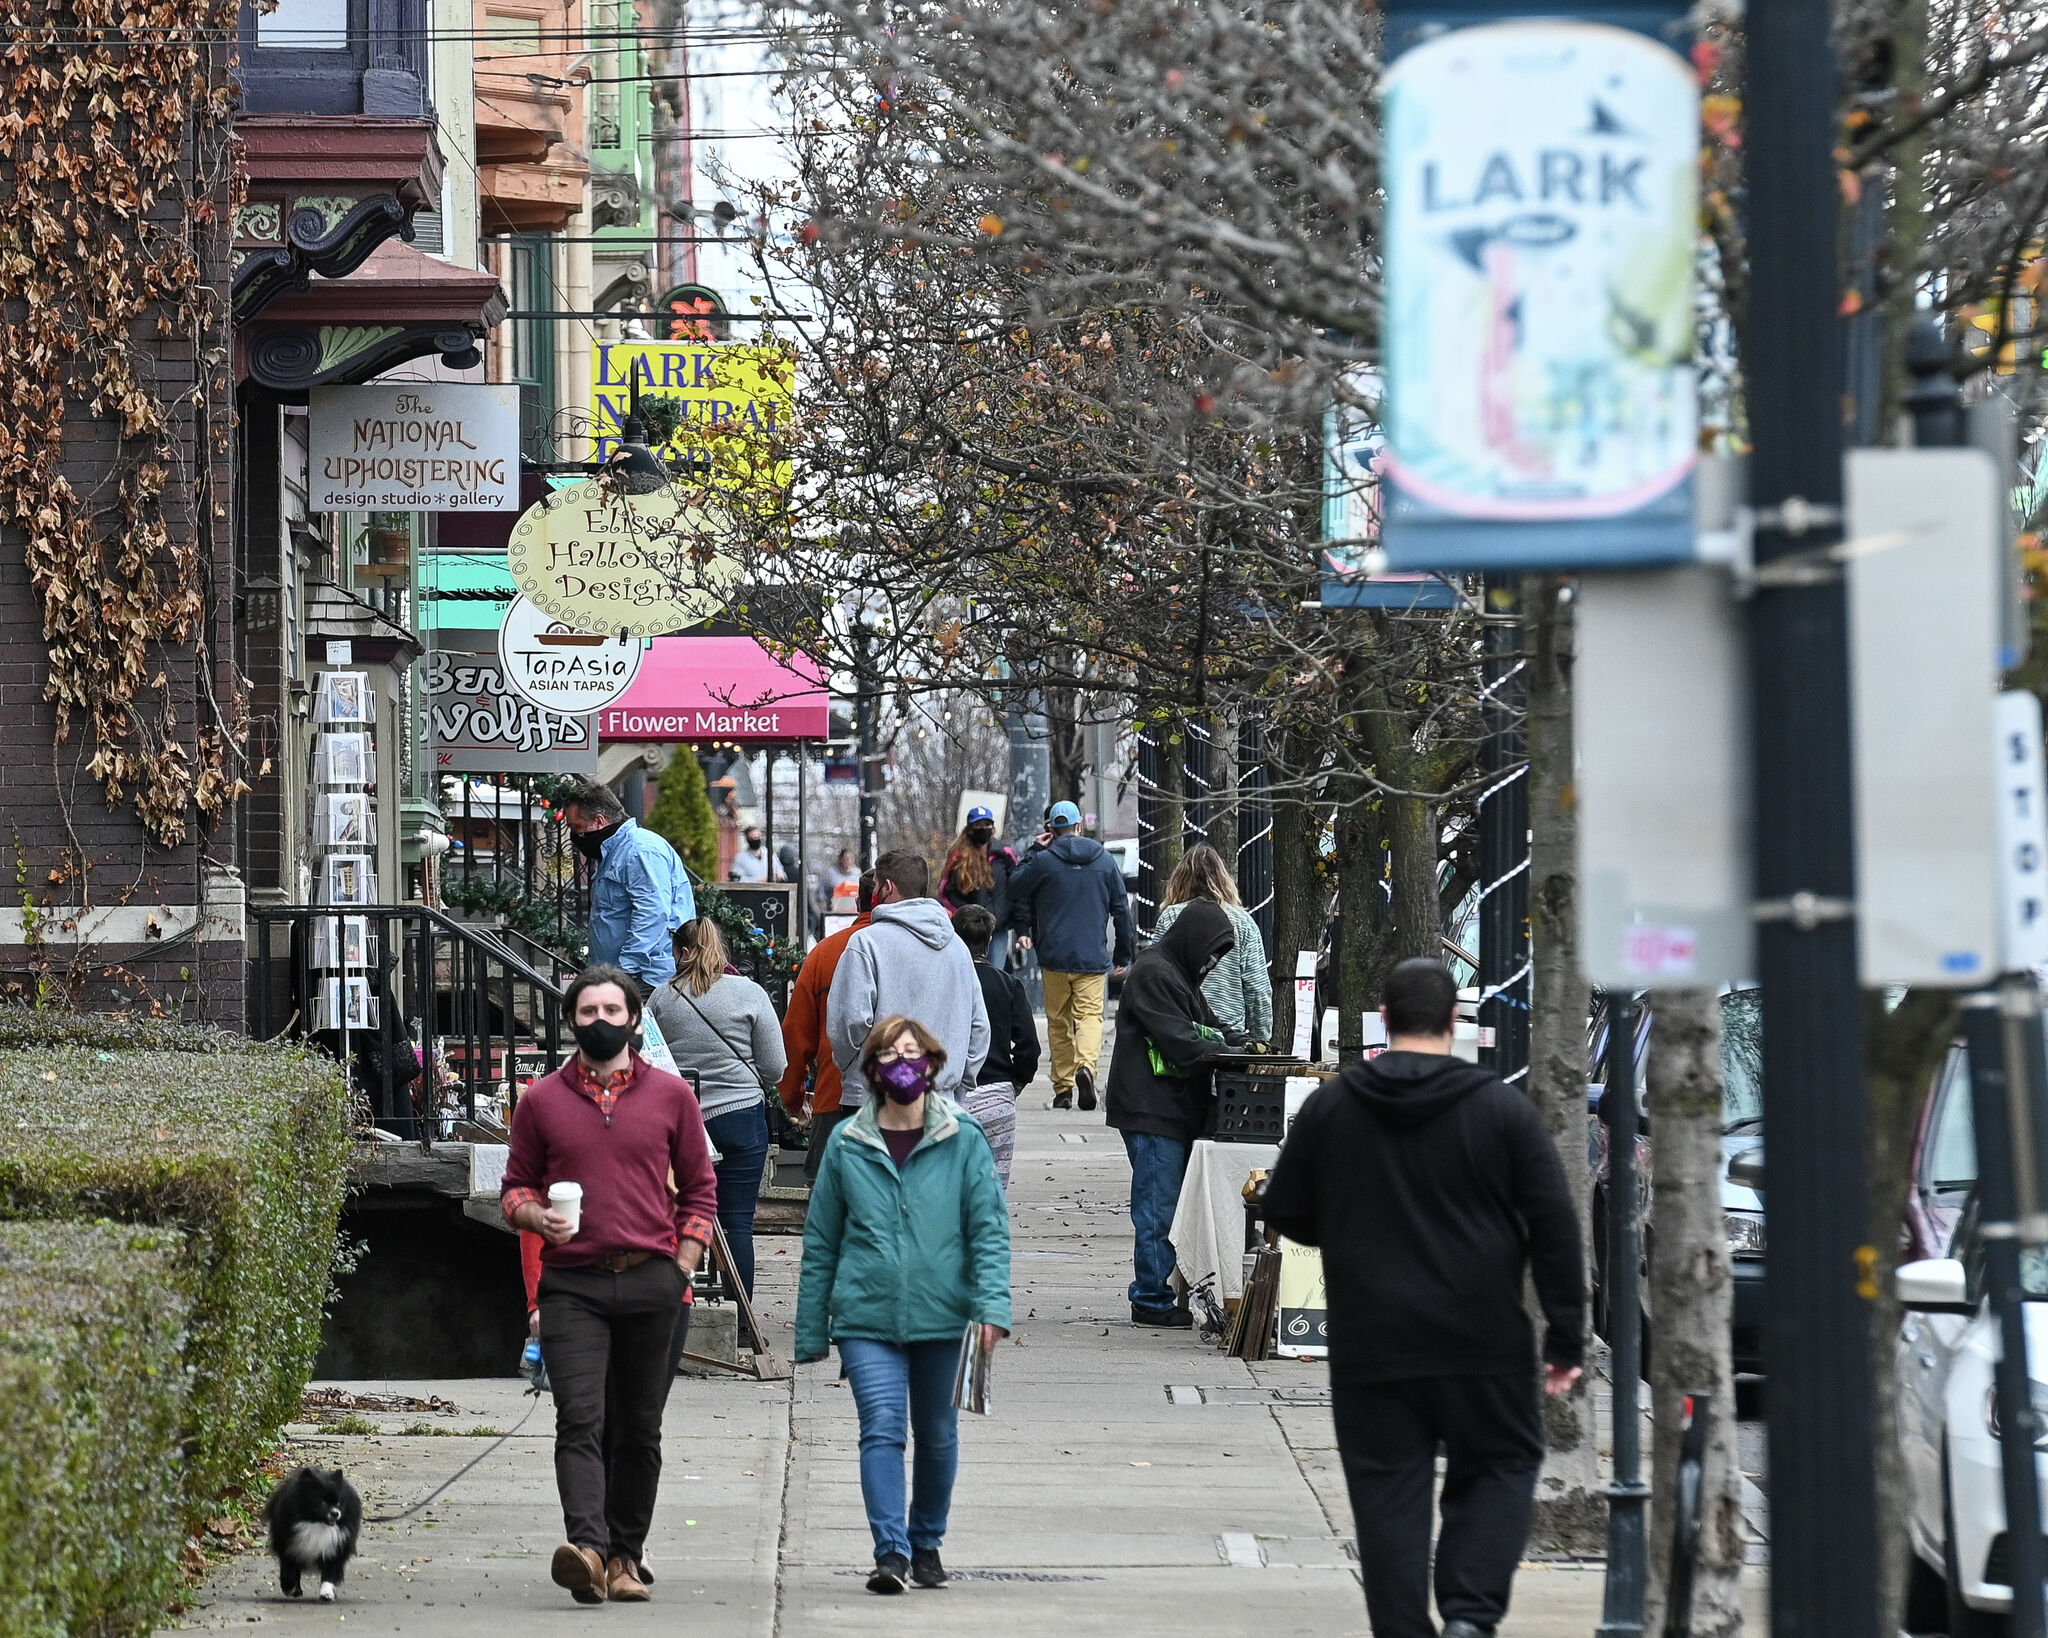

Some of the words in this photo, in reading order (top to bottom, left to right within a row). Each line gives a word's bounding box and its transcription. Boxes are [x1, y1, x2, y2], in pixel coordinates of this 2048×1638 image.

[1422, 150, 1651, 213] LARK
[595, 345, 719, 388] LARK
[395, 394, 434, 414] The
[353, 418, 477, 453] NATIONAL
[323, 457, 505, 491] UPHOLSTERING
[324, 492, 376, 507] design
[381, 492, 431, 505] studio
[449, 492, 504, 507] gallery
[583, 507, 676, 535] Elissa
[555, 574, 692, 606] Designs
[513, 651, 627, 679] TapAsia
[529, 680, 569, 691] ASIAN
[573, 680, 614, 691] TAPAS
[609, 711, 689, 733] Flower
[696, 711, 780, 733] Market
